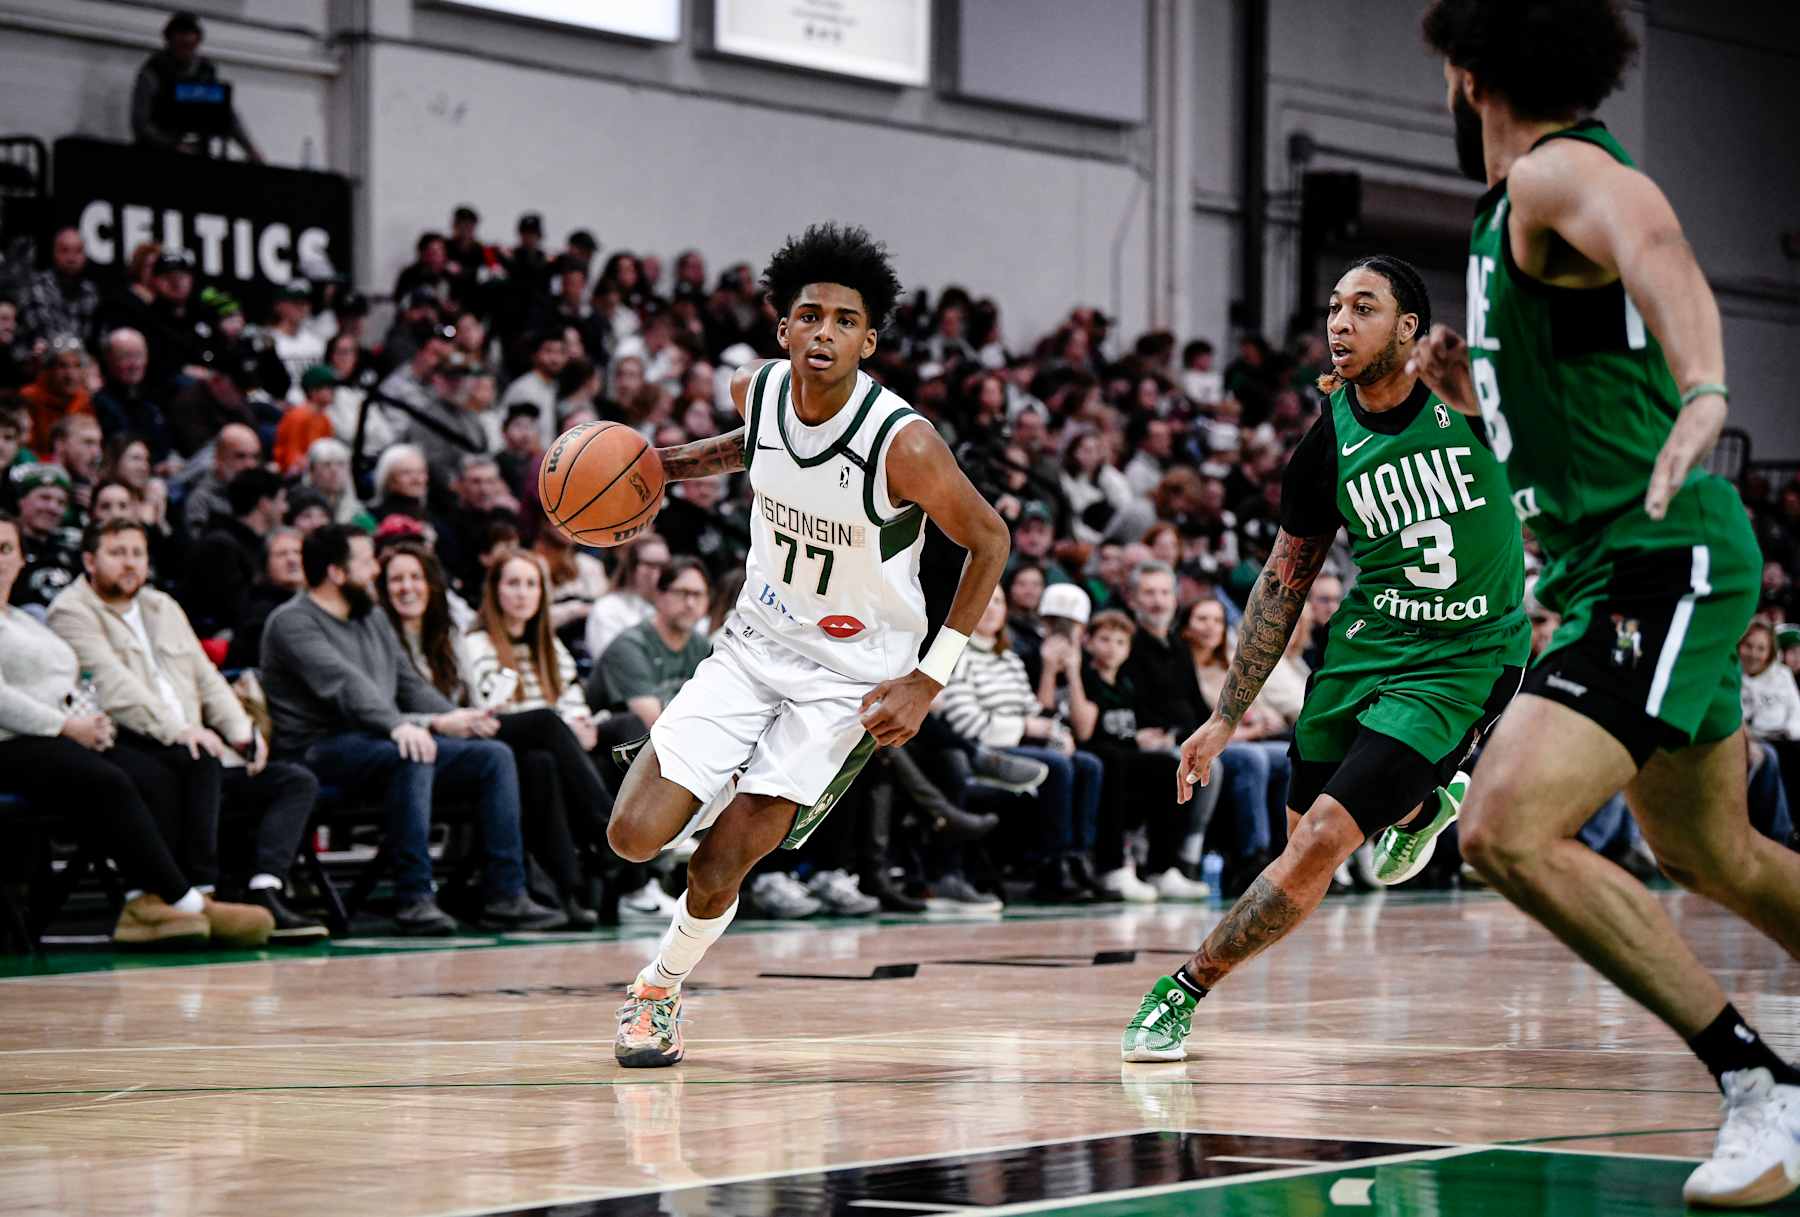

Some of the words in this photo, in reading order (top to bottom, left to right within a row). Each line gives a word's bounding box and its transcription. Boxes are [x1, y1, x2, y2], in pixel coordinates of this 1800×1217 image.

[754, 487, 852, 546] ISCONSIN
[1346, 447, 1487, 539] MAINE
[774, 530, 834, 596] 77
[1400, 517, 1457, 590] 3
[1373, 588, 1489, 622] Amica
